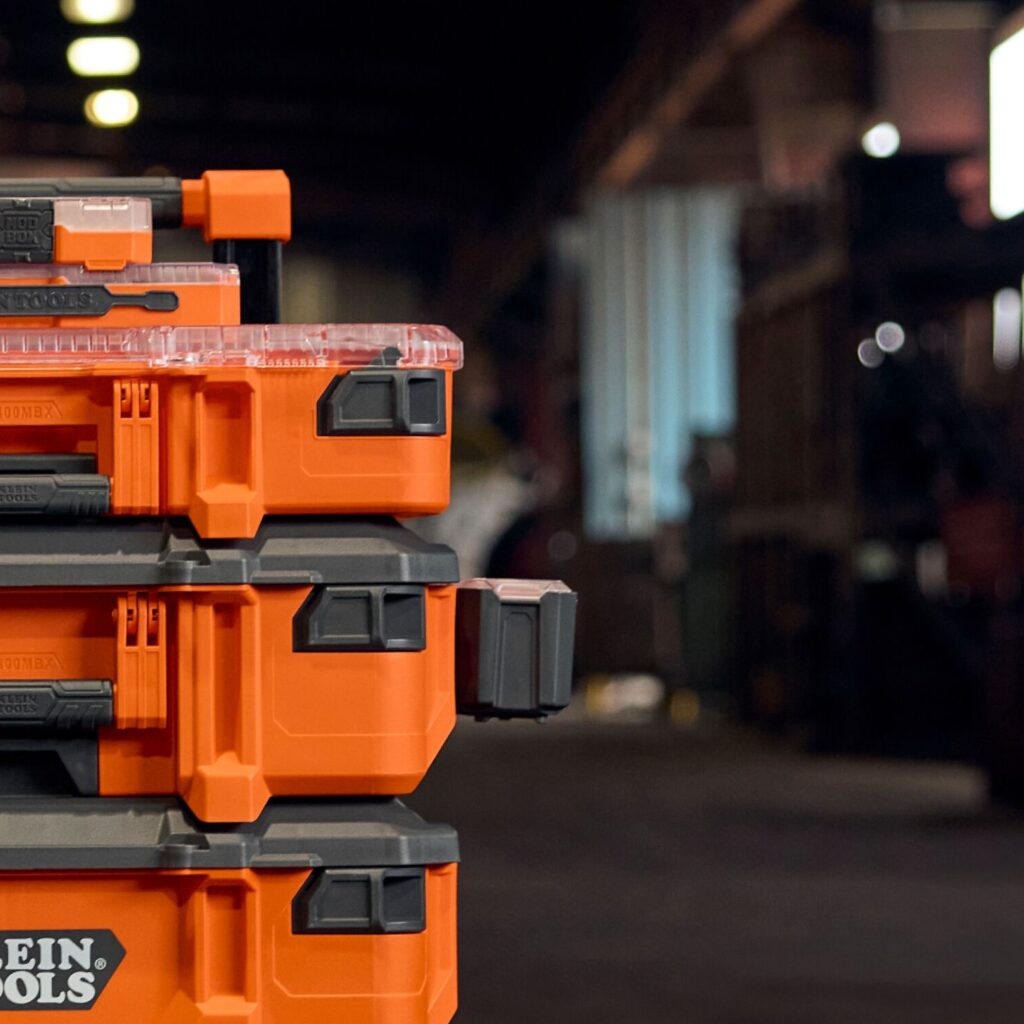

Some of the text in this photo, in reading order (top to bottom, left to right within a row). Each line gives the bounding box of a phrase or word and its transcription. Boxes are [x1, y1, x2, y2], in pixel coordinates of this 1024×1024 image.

[4, 217, 39, 230] MOD
[6, 231, 41, 245] BOX
[15, 291, 94, 310] TOOLS
